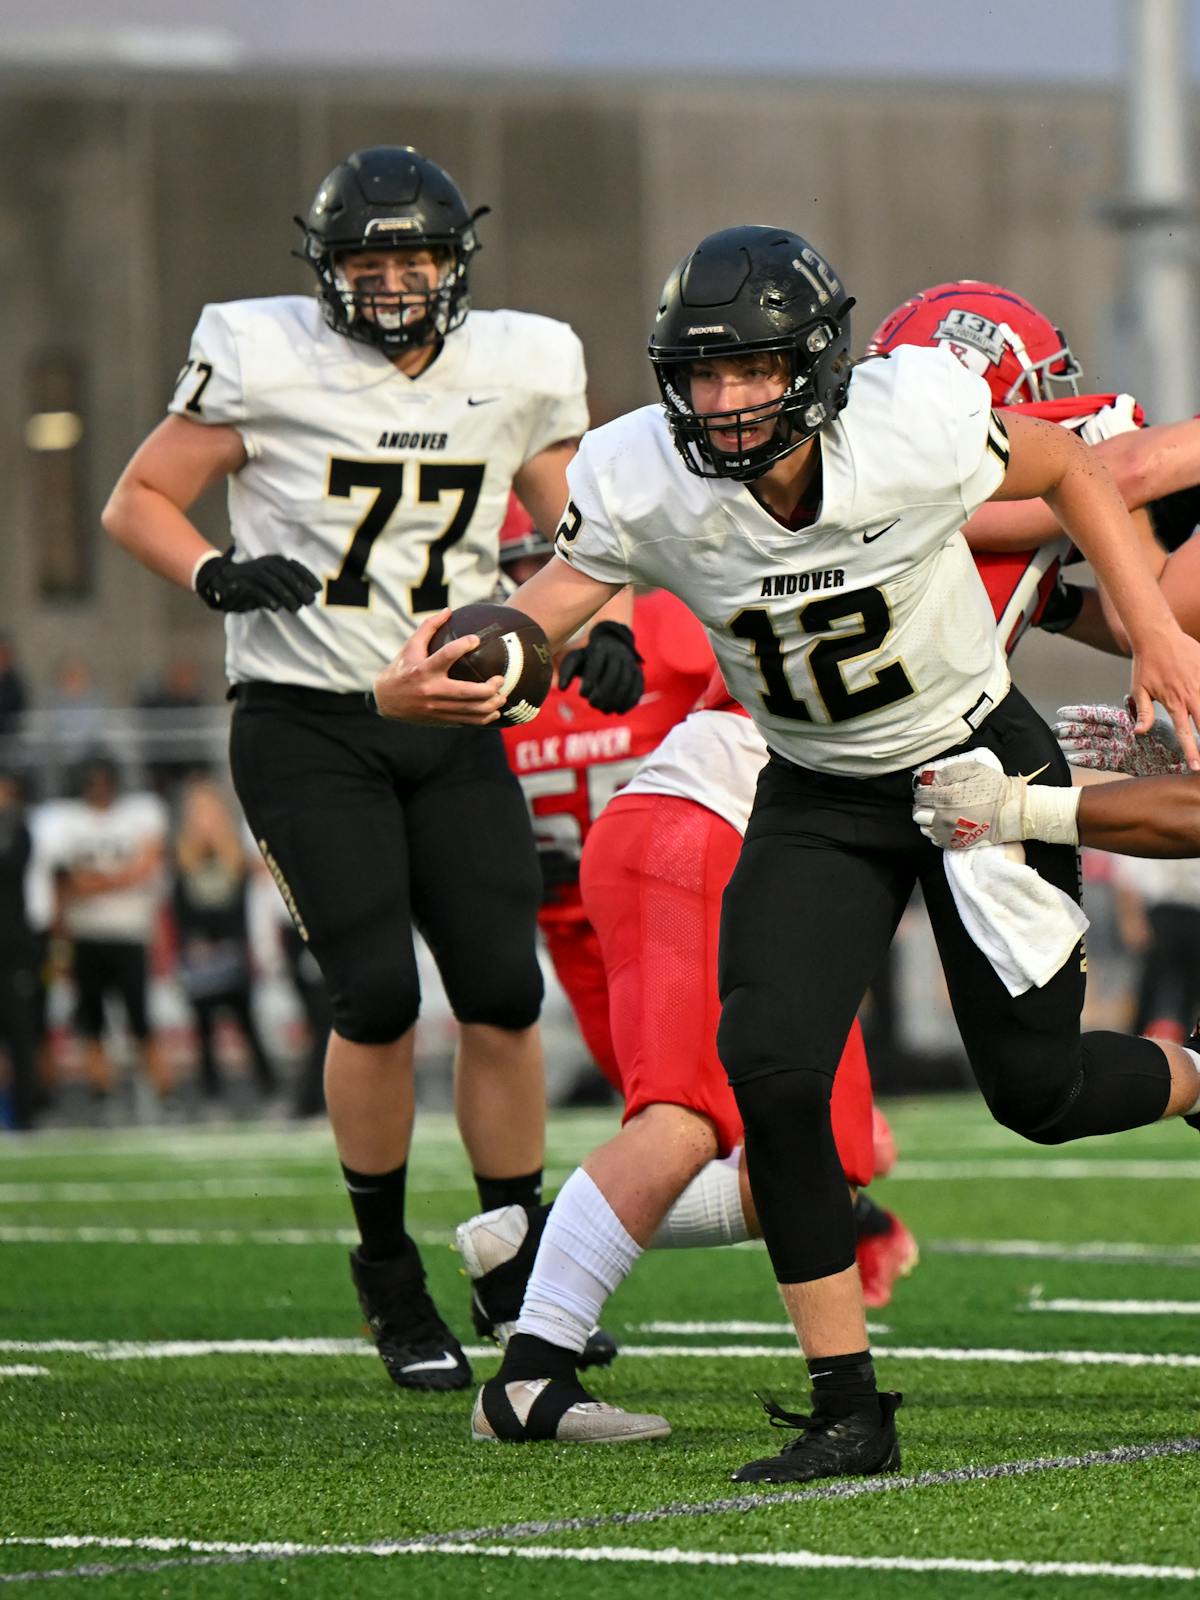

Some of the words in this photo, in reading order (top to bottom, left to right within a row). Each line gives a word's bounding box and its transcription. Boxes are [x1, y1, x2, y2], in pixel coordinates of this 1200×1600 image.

[792, 248, 841, 306] 12
[687, 325, 725, 336] ANDOVER
[953, 312, 998, 340] 131
[377, 431, 449, 451] ANDOVER
[323, 456, 489, 616] 77
[760, 568, 846, 598] ANDOVER
[724, 585, 921, 725] 12
[515, 736, 562, 770] ELK
[564, 726, 632, 763] RIVER
